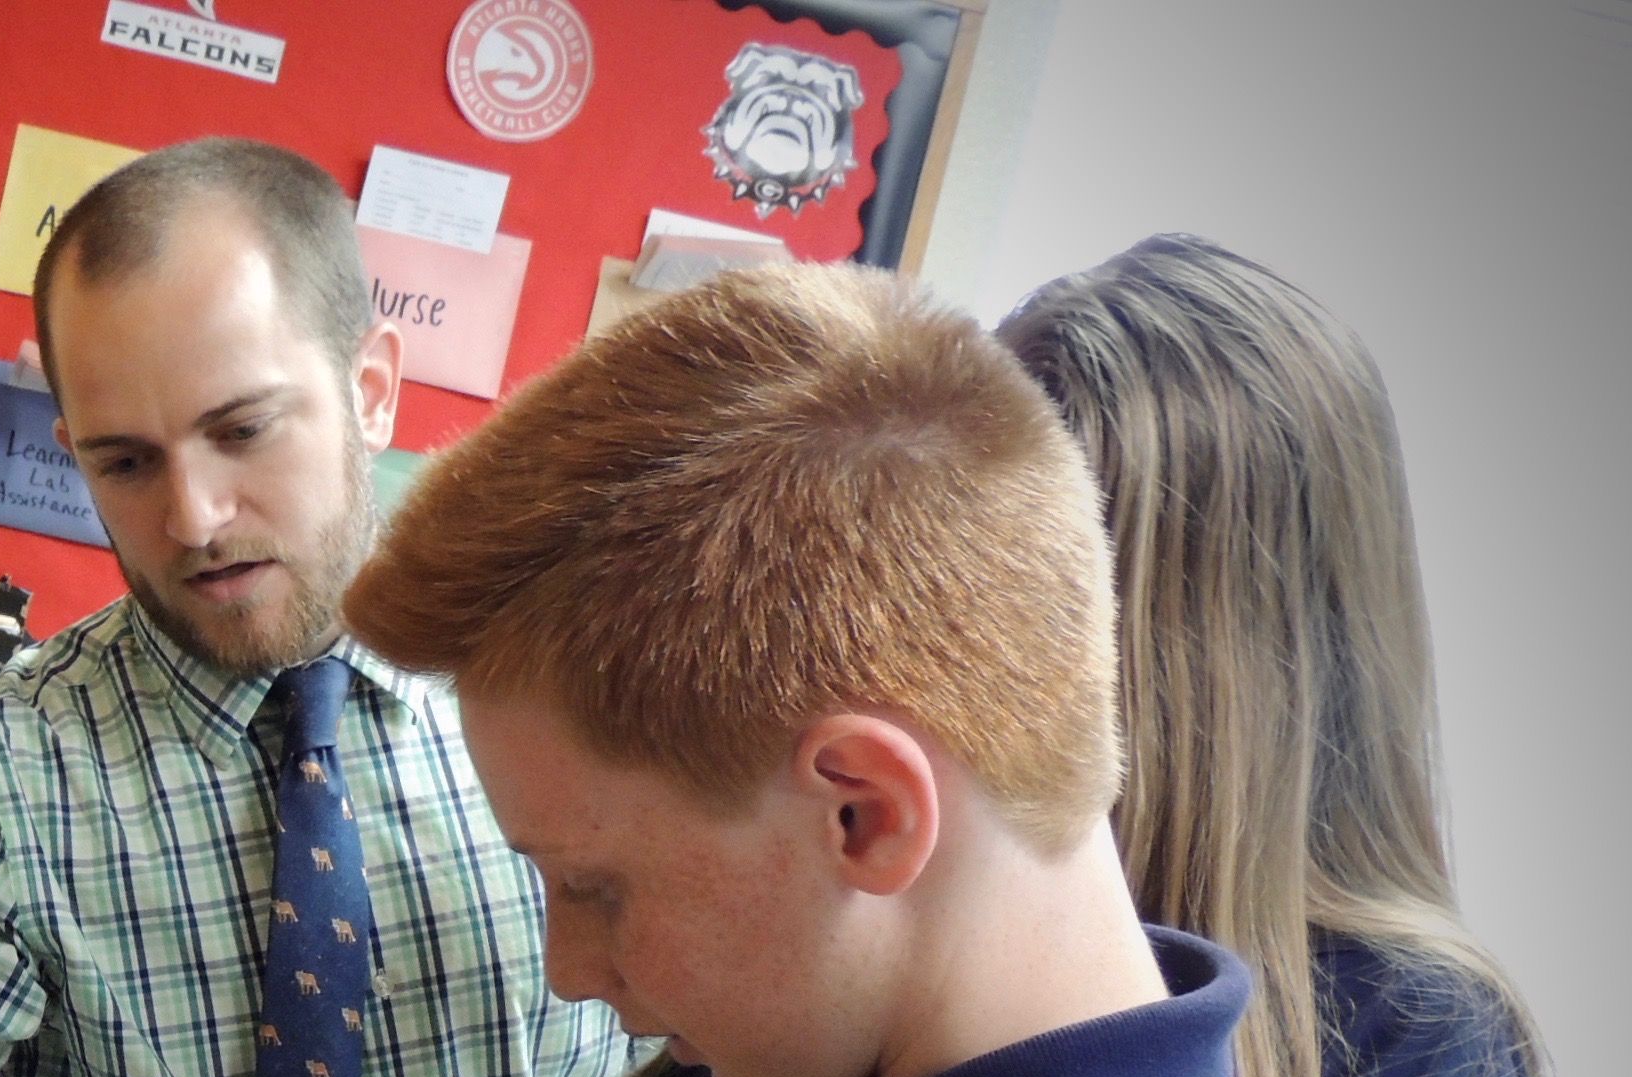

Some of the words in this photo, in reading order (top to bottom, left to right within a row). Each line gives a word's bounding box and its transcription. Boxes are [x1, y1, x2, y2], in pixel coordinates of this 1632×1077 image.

[109, 19, 276, 76] FALCONS
[148, 13, 242, 46] ATLANTA
[469, 0, 540, 37] ATLANTA
[544, 5, 585, 64] HAWKS
[458, 56, 537, 131] BASKETBALL
[541, 83, 579, 124] CLUB
[29, 467, 70, 493] Lab
